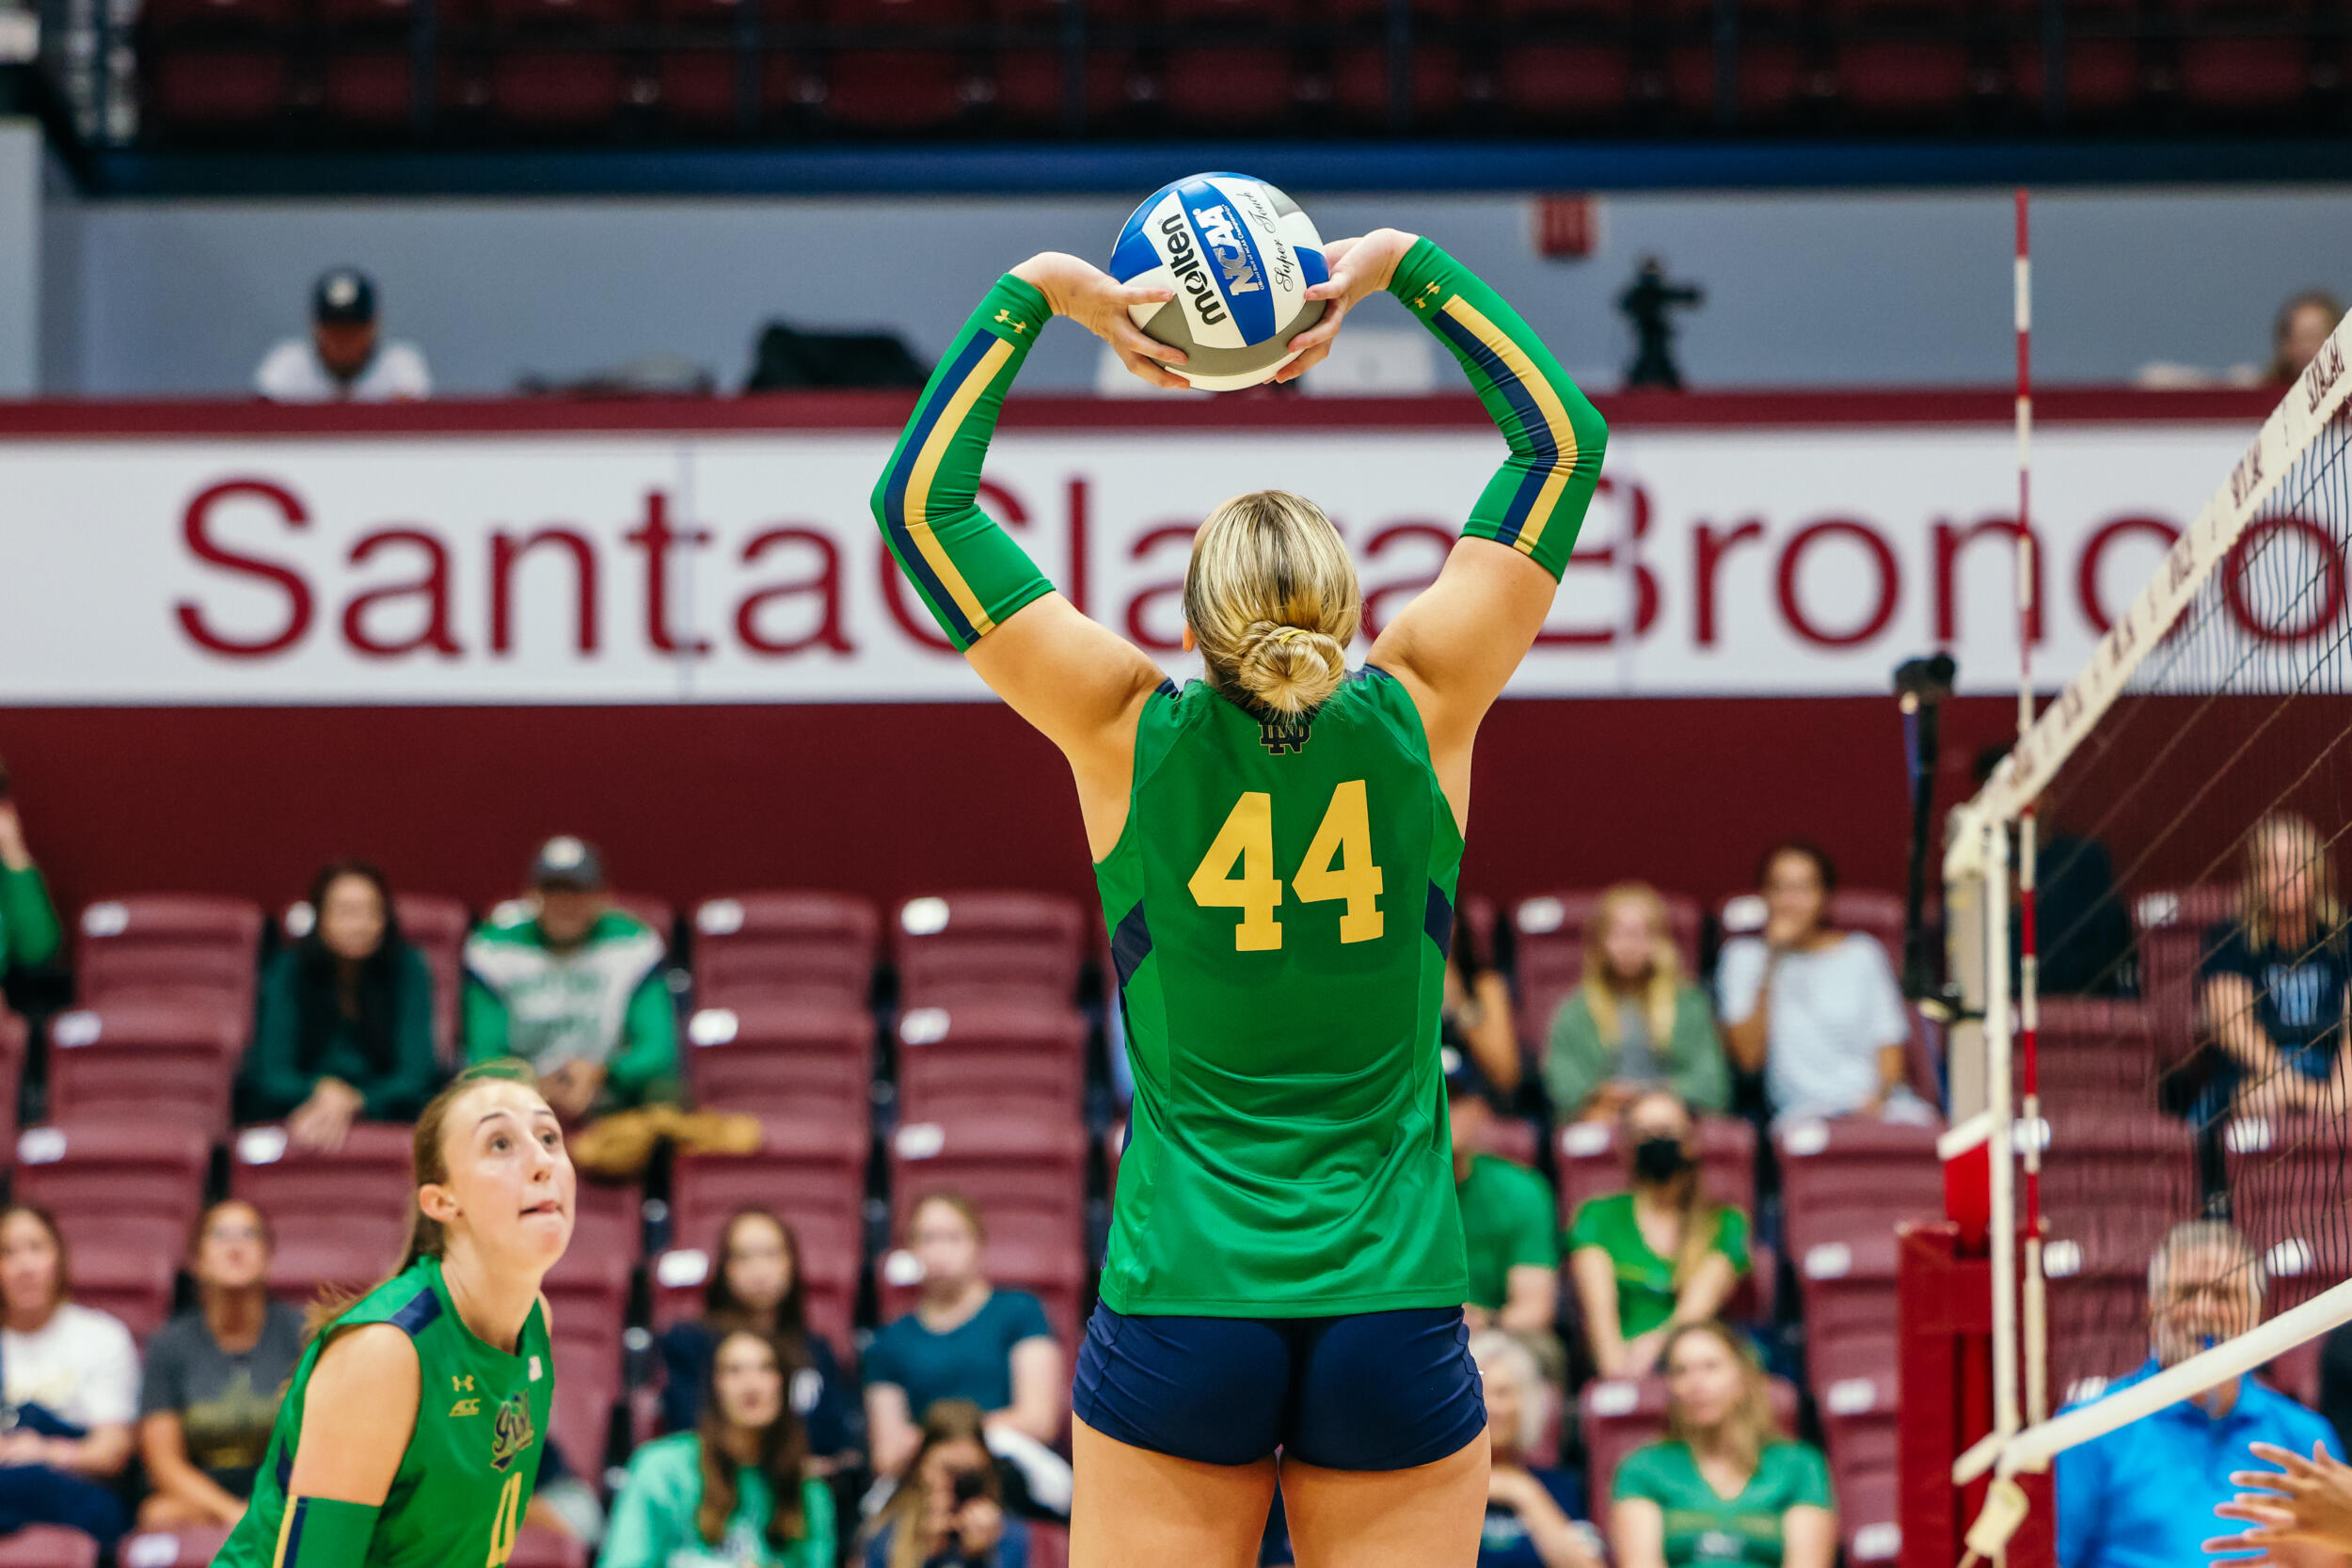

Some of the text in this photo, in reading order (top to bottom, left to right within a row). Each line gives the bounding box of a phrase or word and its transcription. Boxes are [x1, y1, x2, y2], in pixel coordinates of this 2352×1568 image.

[1161, 213, 1227, 325] molten
[1194, 203, 1261, 297] NCAA
[1235, 191, 1295, 293] Super Touch
[1187, 779, 1384, 952] 44
